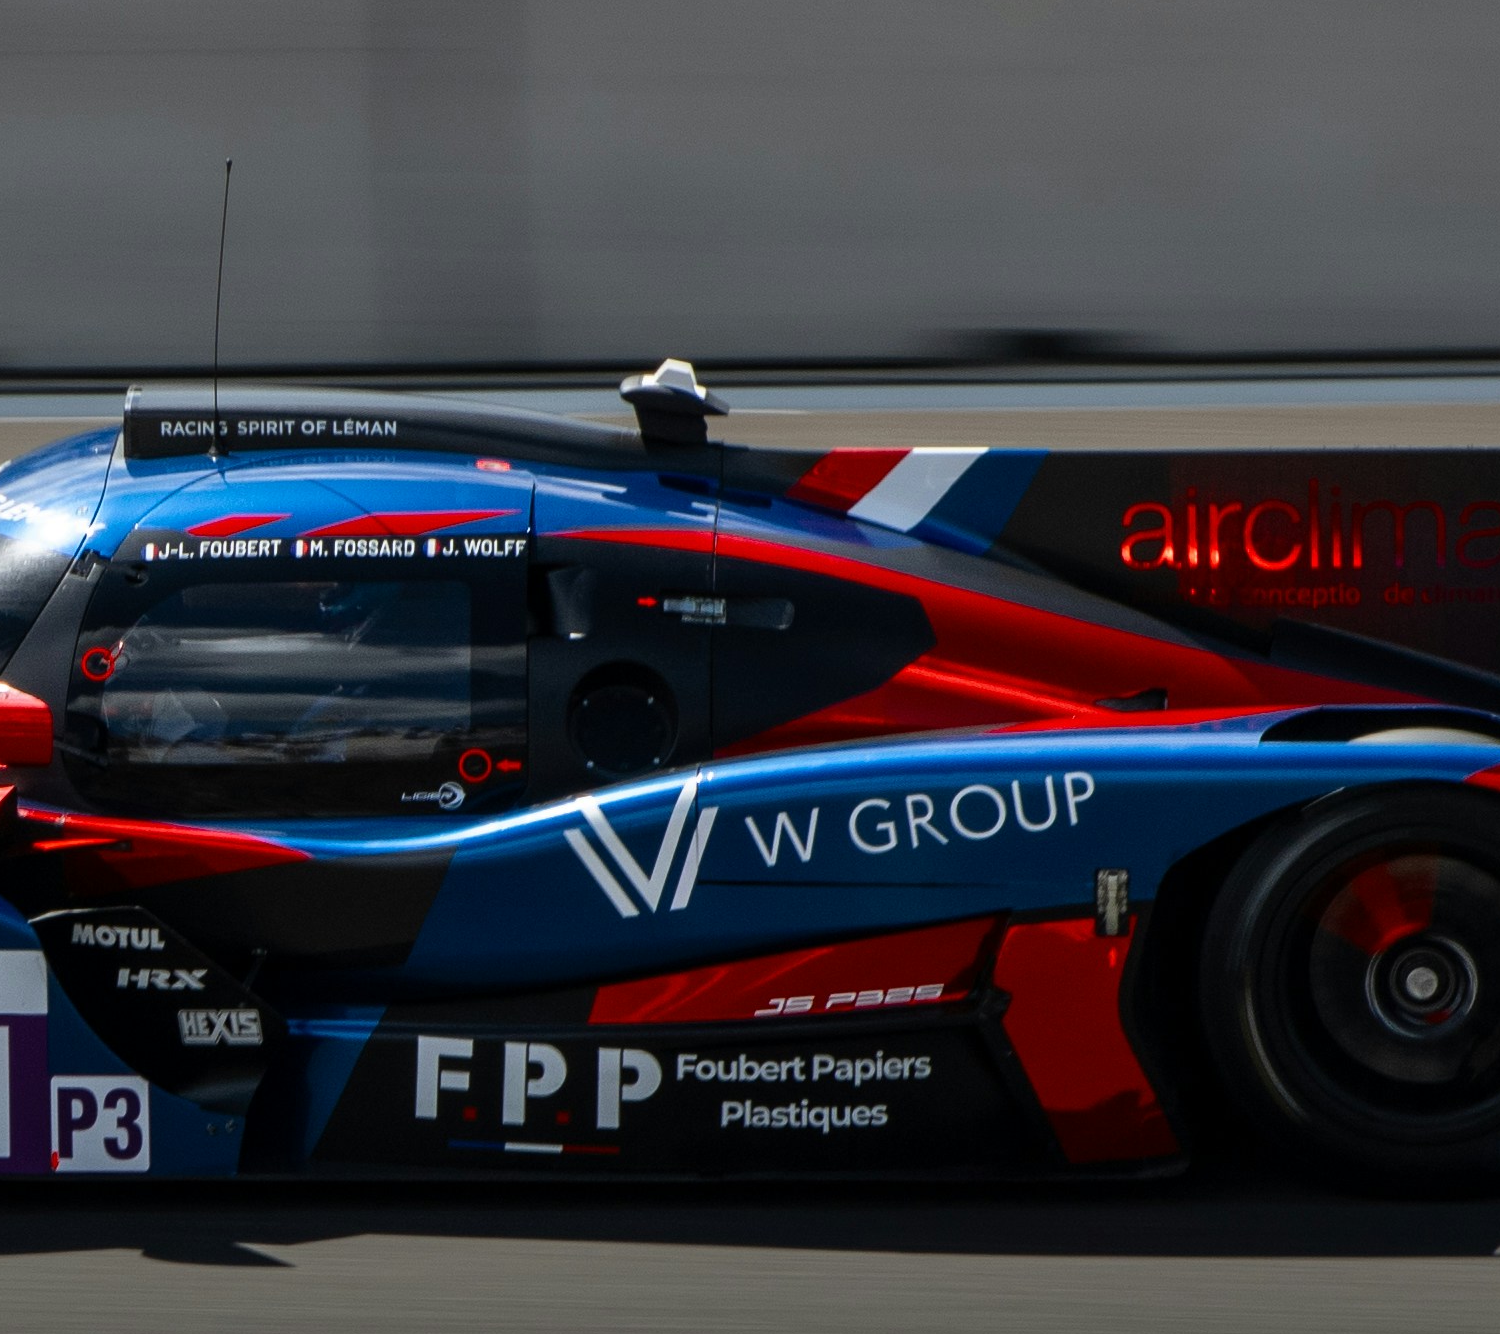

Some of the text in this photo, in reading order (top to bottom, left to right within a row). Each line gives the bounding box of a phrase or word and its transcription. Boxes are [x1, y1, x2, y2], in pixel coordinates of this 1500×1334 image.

[160, 417, 397, 436] RACING SPIRIT OF LÉMAN
[158, 539, 282, 559] J-L. FOUBERT
[309, 539, 416, 558] M. FOSSARD
[442, 539, 527, 558] J. WOLFF
[744, 770, 1095, 868] W GROUP
[71, 923, 166, 950] MOTUL
[116, 968, 208, 990] HRX
[753, 995, 815, 1017] JS
[180, 1009, 261, 1042] HEXIS
[676, 1051, 932, 1088] Foubert Papiers
[56, 1086, 144, 1160] P3
[720, 1099, 888, 1134] Plastiques
